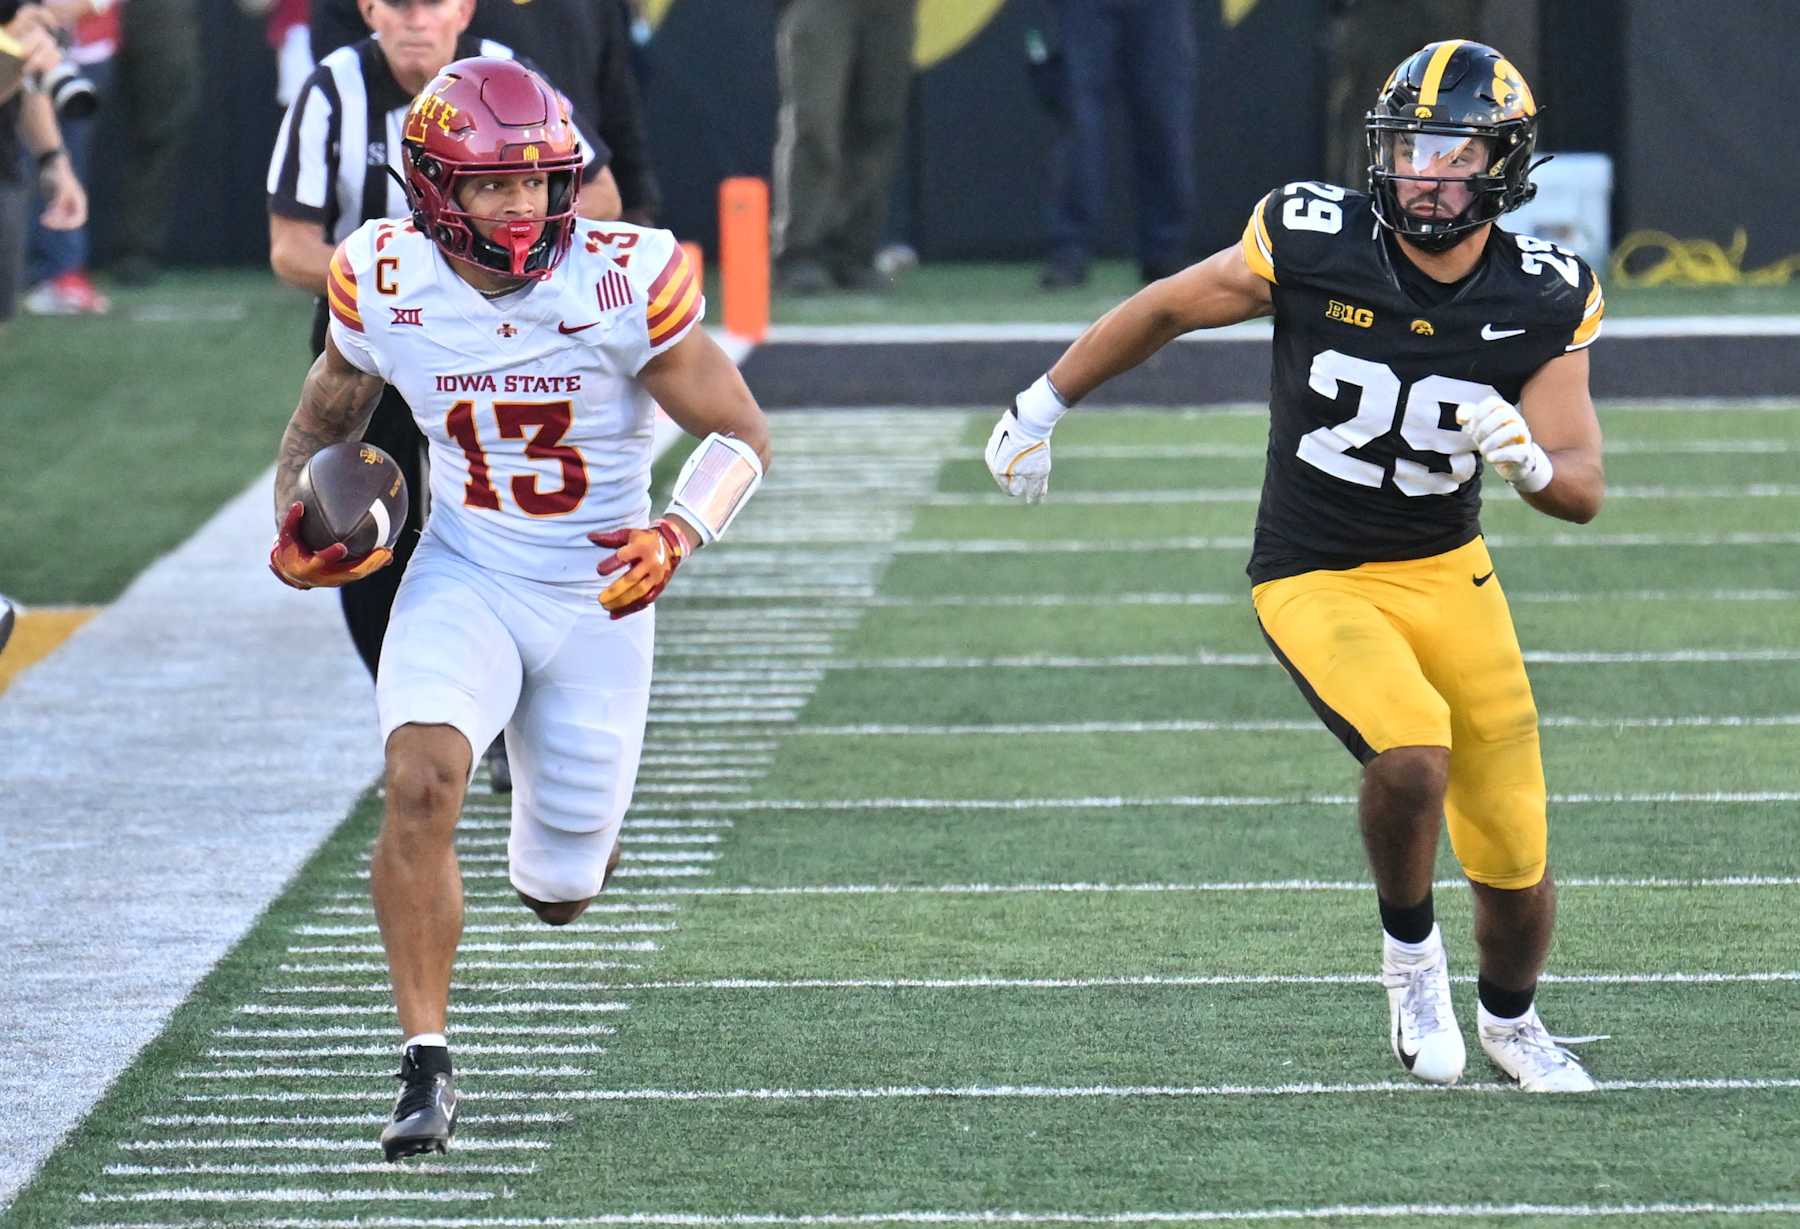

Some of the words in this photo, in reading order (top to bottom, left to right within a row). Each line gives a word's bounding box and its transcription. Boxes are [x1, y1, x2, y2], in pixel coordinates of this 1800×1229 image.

[1283, 181, 1343, 235] 29
[376, 256, 399, 295] C
[389, 307, 423, 326] XII
[435, 375, 496, 392] IOWA
[504, 375, 581, 393] STATE
[1296, 349, 1502, 497] 29
[445, 399, 591, 518] 13
